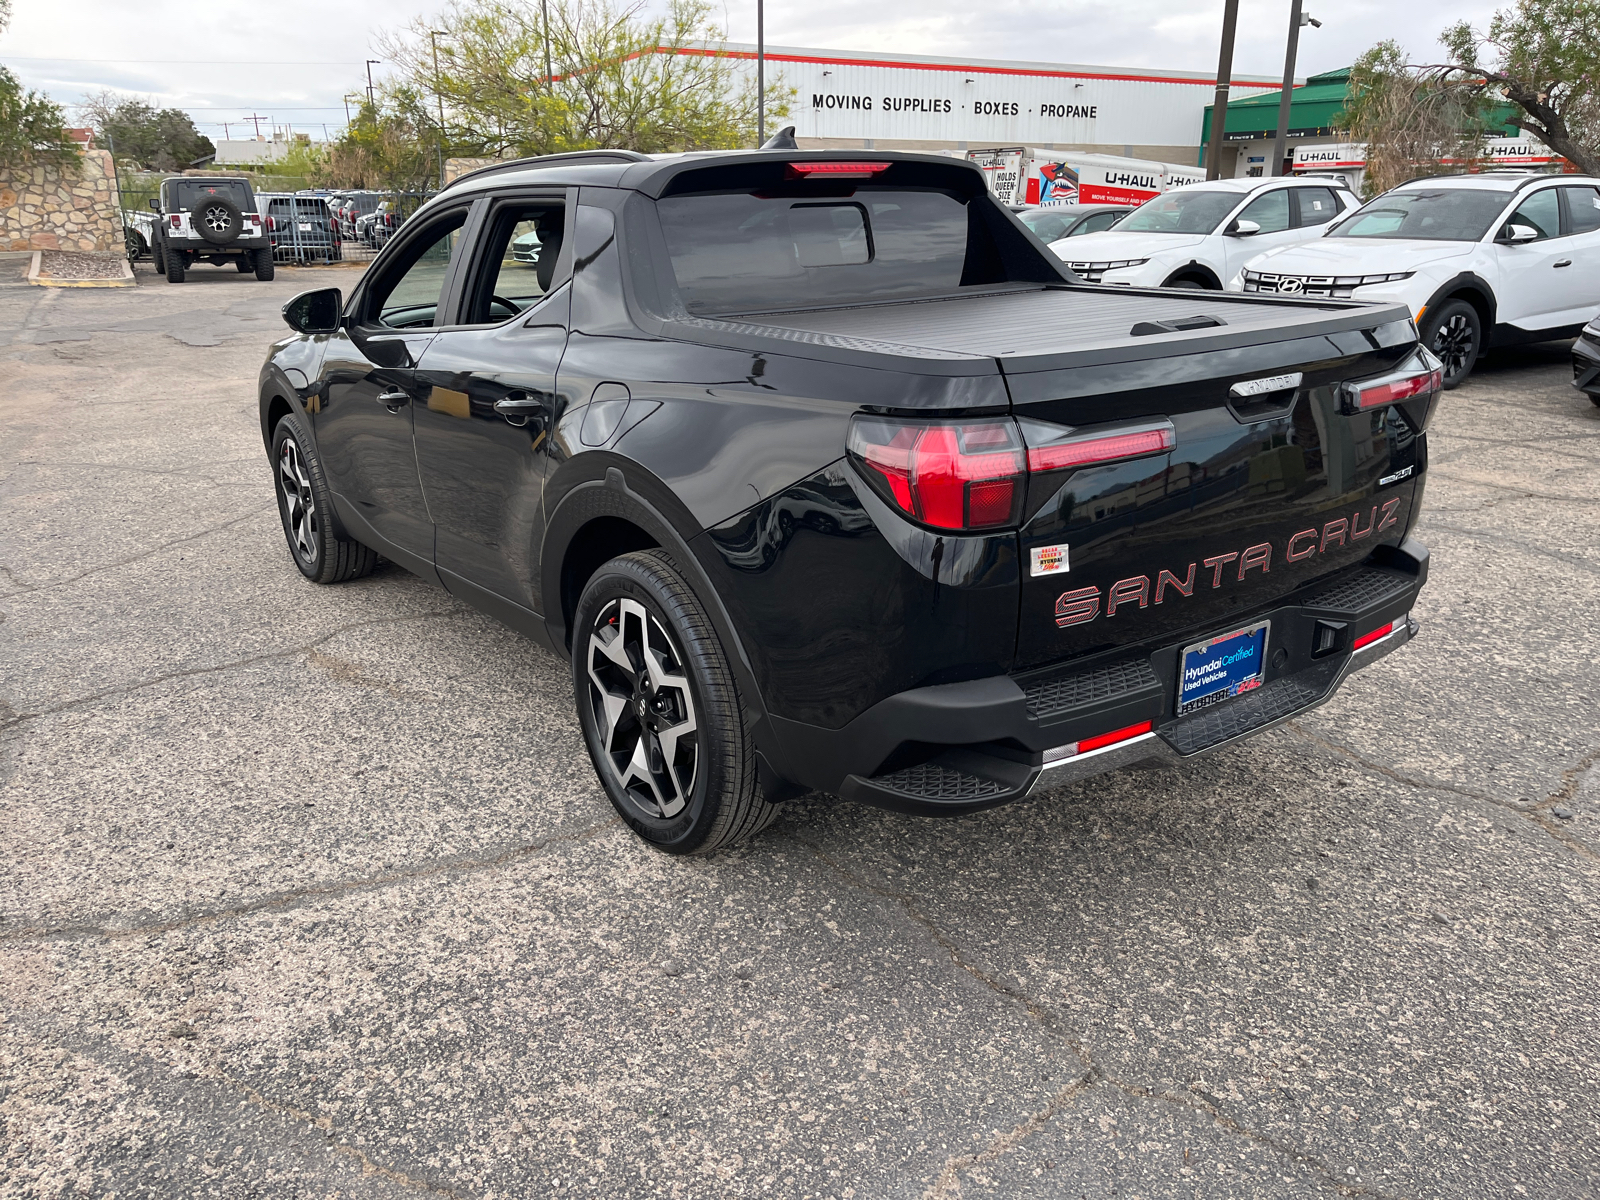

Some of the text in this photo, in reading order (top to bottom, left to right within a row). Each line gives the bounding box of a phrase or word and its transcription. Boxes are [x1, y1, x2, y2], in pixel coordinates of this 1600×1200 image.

[813, 94, 1097, 119] MOVING SUPPLIES BOXES PROPANE
[1300, 152, 1341, 162] U-HAUL
[997, 172, 1017, 182] HOLDS
[1105, 172, 1157, 189] U-HAUL
[1166, 176, 1204, 186] U-HA
[995, 182, 1016, 191] QUEEN-
[998, 191, 1011, 200] SIZE
[1106, 195, 1129, 204] YOURSELF
[1040, 557, 1062, 565] HYUNDAI
[1055, 498, 1400, 628] SANTA CRUZ
[1184, 679, 1201, 692] Used
[1202, 670, 1228, 686] Vehicles
[1181, 688, 1229, 714] HYUNDAI
